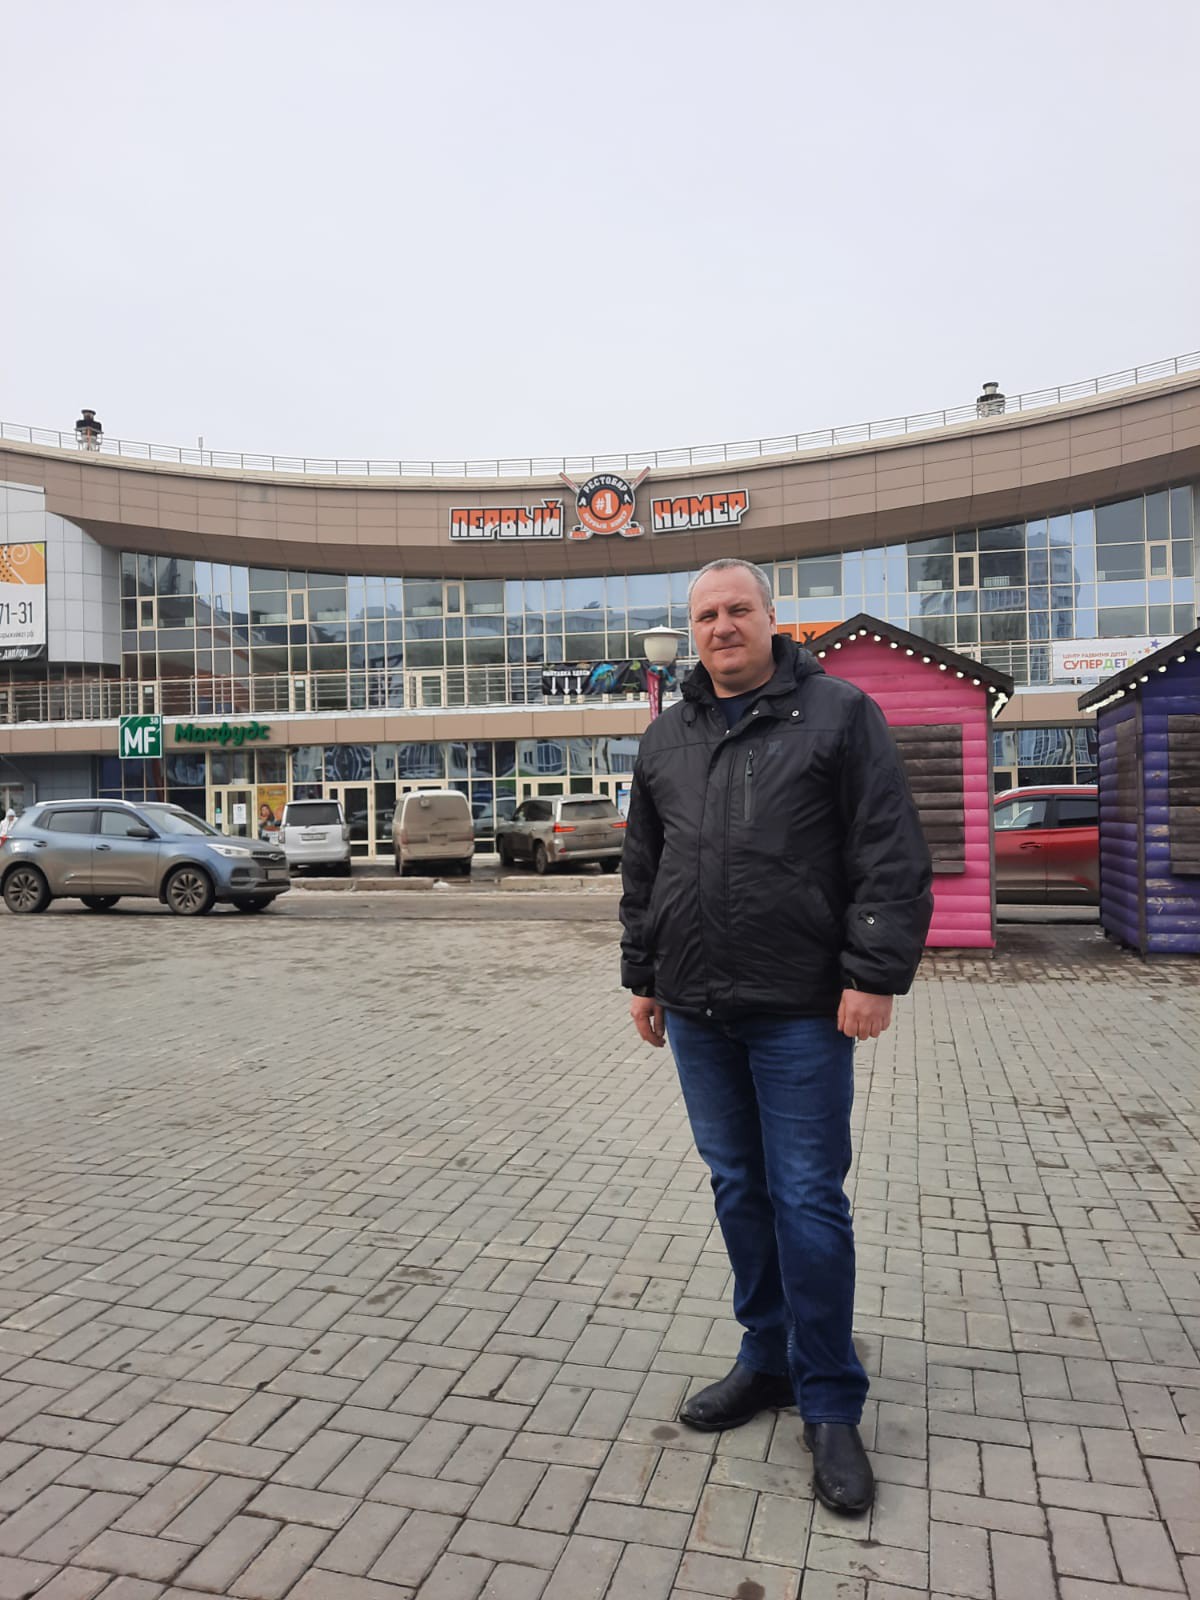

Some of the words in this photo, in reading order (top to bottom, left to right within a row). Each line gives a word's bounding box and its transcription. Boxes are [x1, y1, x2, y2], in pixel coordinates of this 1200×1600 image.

[583, 476, 628, 494] РЕСТОБАР
[451, 501, 561, 538] ПЕРВЫЙ
[652, 491, 748, 531] НОМЕР
[595, 493, 613, 514] #1
[124, 727, 157, 757] MF
[174, 720, 271, 746] Макфудс
